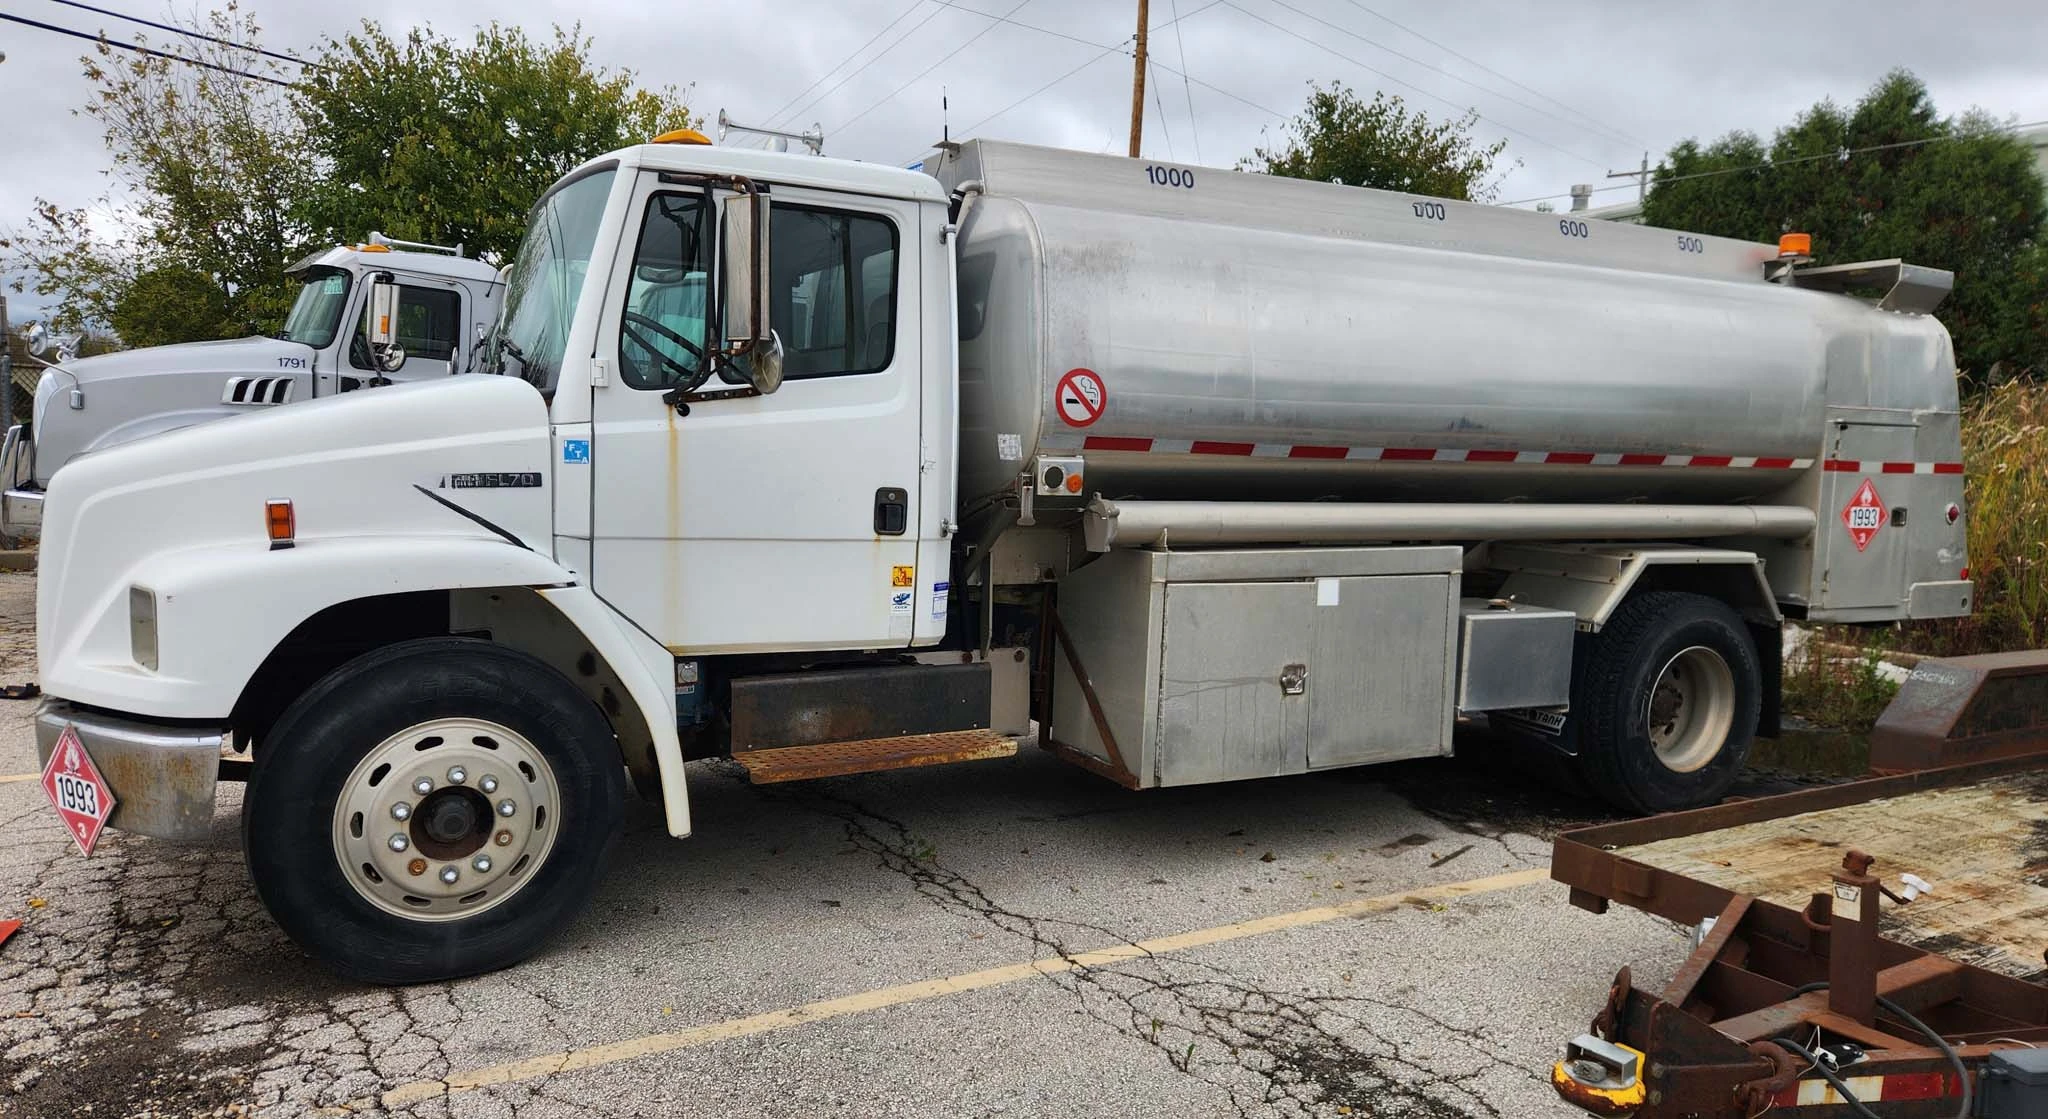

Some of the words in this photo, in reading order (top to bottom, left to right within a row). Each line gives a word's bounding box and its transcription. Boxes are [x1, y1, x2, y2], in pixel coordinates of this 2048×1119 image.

[1145, 165, 1194, 189] 1000
[1559, 219, 1588, 238] 600
[1678, 236, 1703, 253] 500
[277, 357, 306, 369] 1791
[1853, 508, 1877, 526] 1993
[58, 776, 96, 815] 1993
[77, 822, 87, 839] 3
